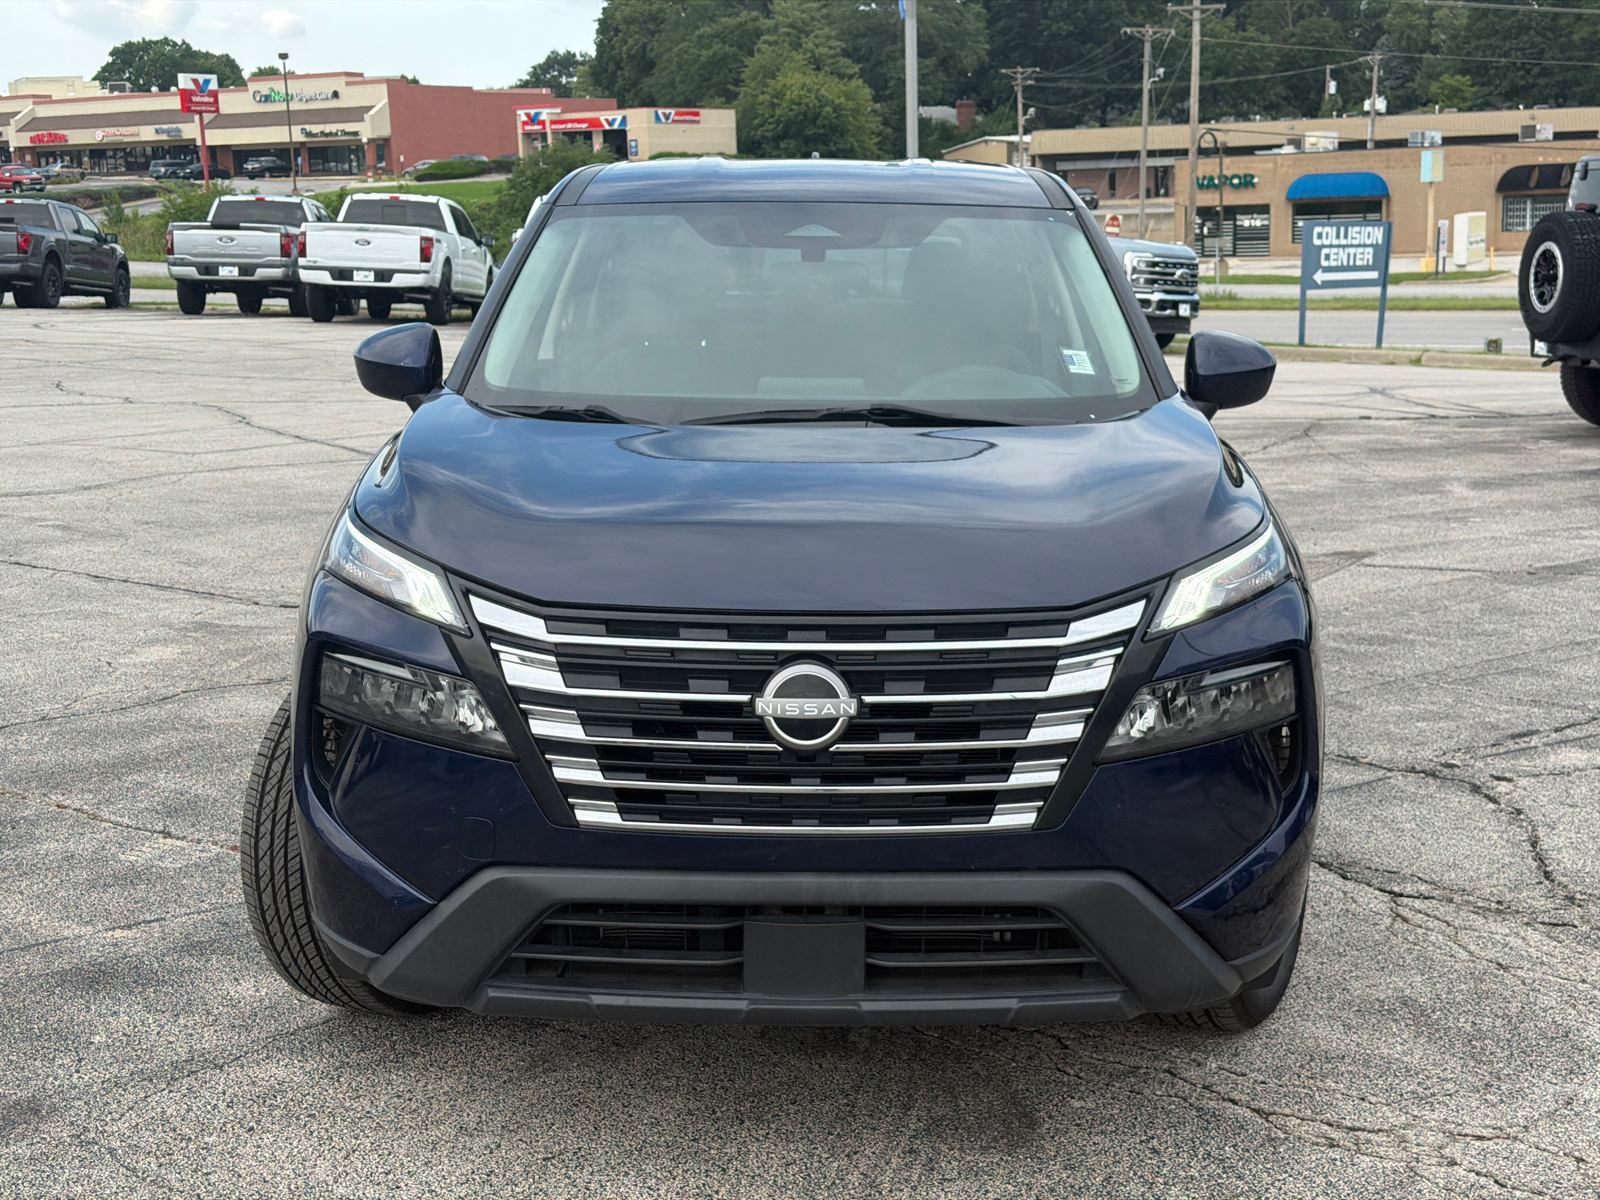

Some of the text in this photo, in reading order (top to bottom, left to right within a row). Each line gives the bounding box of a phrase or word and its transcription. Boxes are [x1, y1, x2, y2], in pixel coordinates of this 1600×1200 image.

[1196, 173, 1256, 190] VAPOR
[1243, 219, 1261, 228] 816
[1312, 226, 1384, 246] COLLISION
[1320, 247, 1374, 267] CENTER
[758, 702, 855, 715] NISSAN
